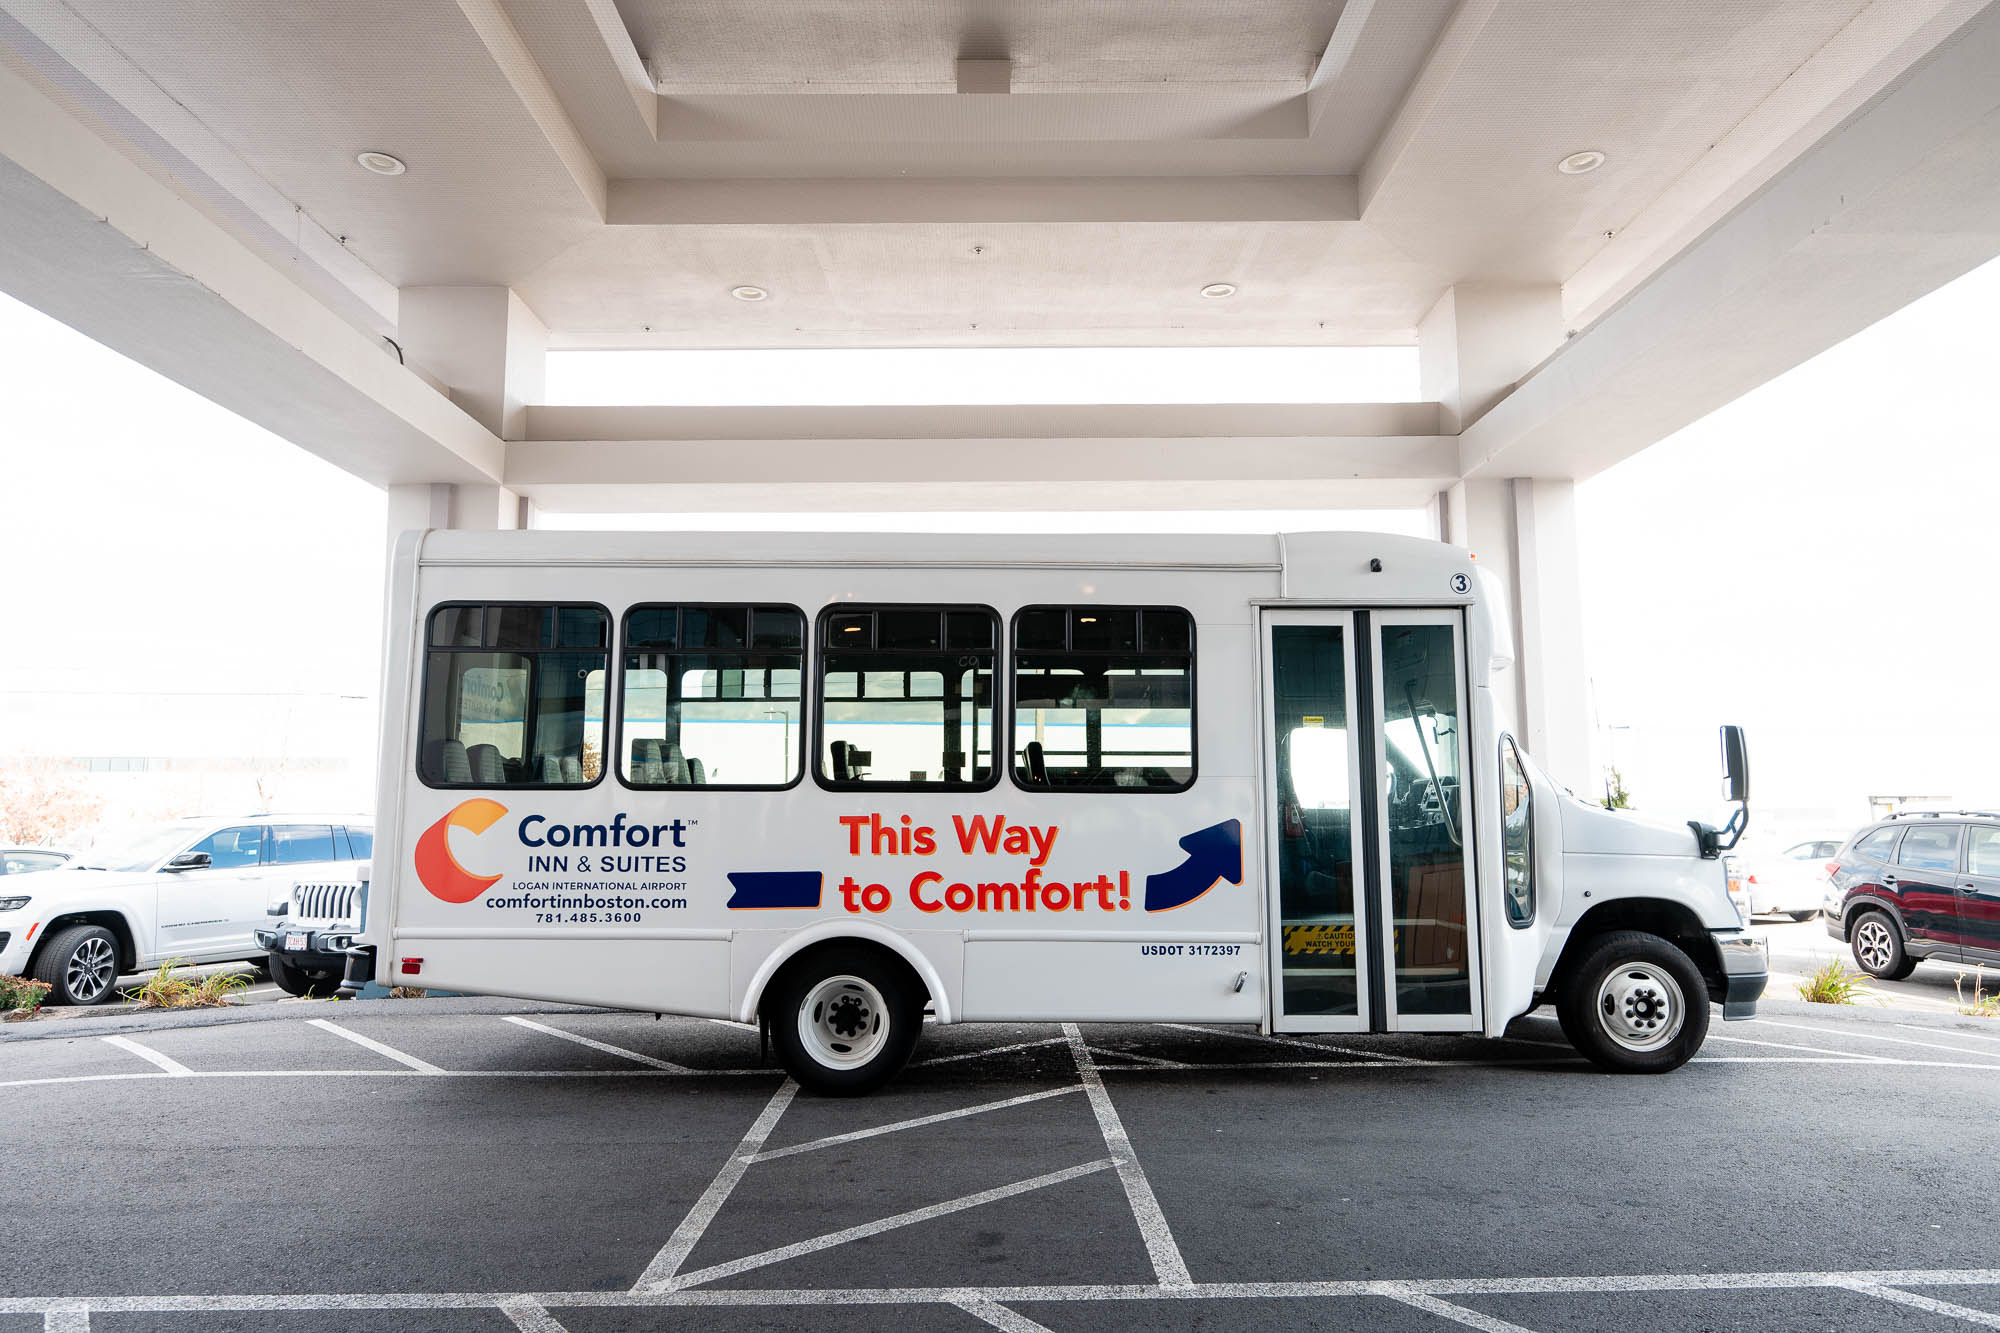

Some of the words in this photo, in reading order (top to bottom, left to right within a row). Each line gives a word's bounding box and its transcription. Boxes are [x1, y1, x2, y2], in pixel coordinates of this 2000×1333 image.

[1455, 575, 1467, 591] 3
[518, 812, 687, 848] Comfort
[838, 813, 938, 857] This
[951, 814, 1060, 867] Way
[528, 855, 568, 873] INN
[576, 855, 592, 873] &
[600, 855, 687, 873] SUITES
[512, 882, 549, 891] LOGAN
[552, 882, 638, 891] INTERNATIONAL
[640, 882, 687, 891] AIRPORT
[838, 876, 892, 914] to
[908, 868, 1132, 914] Comfort!
[486, 893, 687, 909] comfortinnboston.com
[535, 912, 641, 923] 781.485.3600
[1324, 932, 1355, 940] CAUTIO
[1141, 945, 1183, 955] USDOT
[1188, 945, 1241, 955] 3172397
